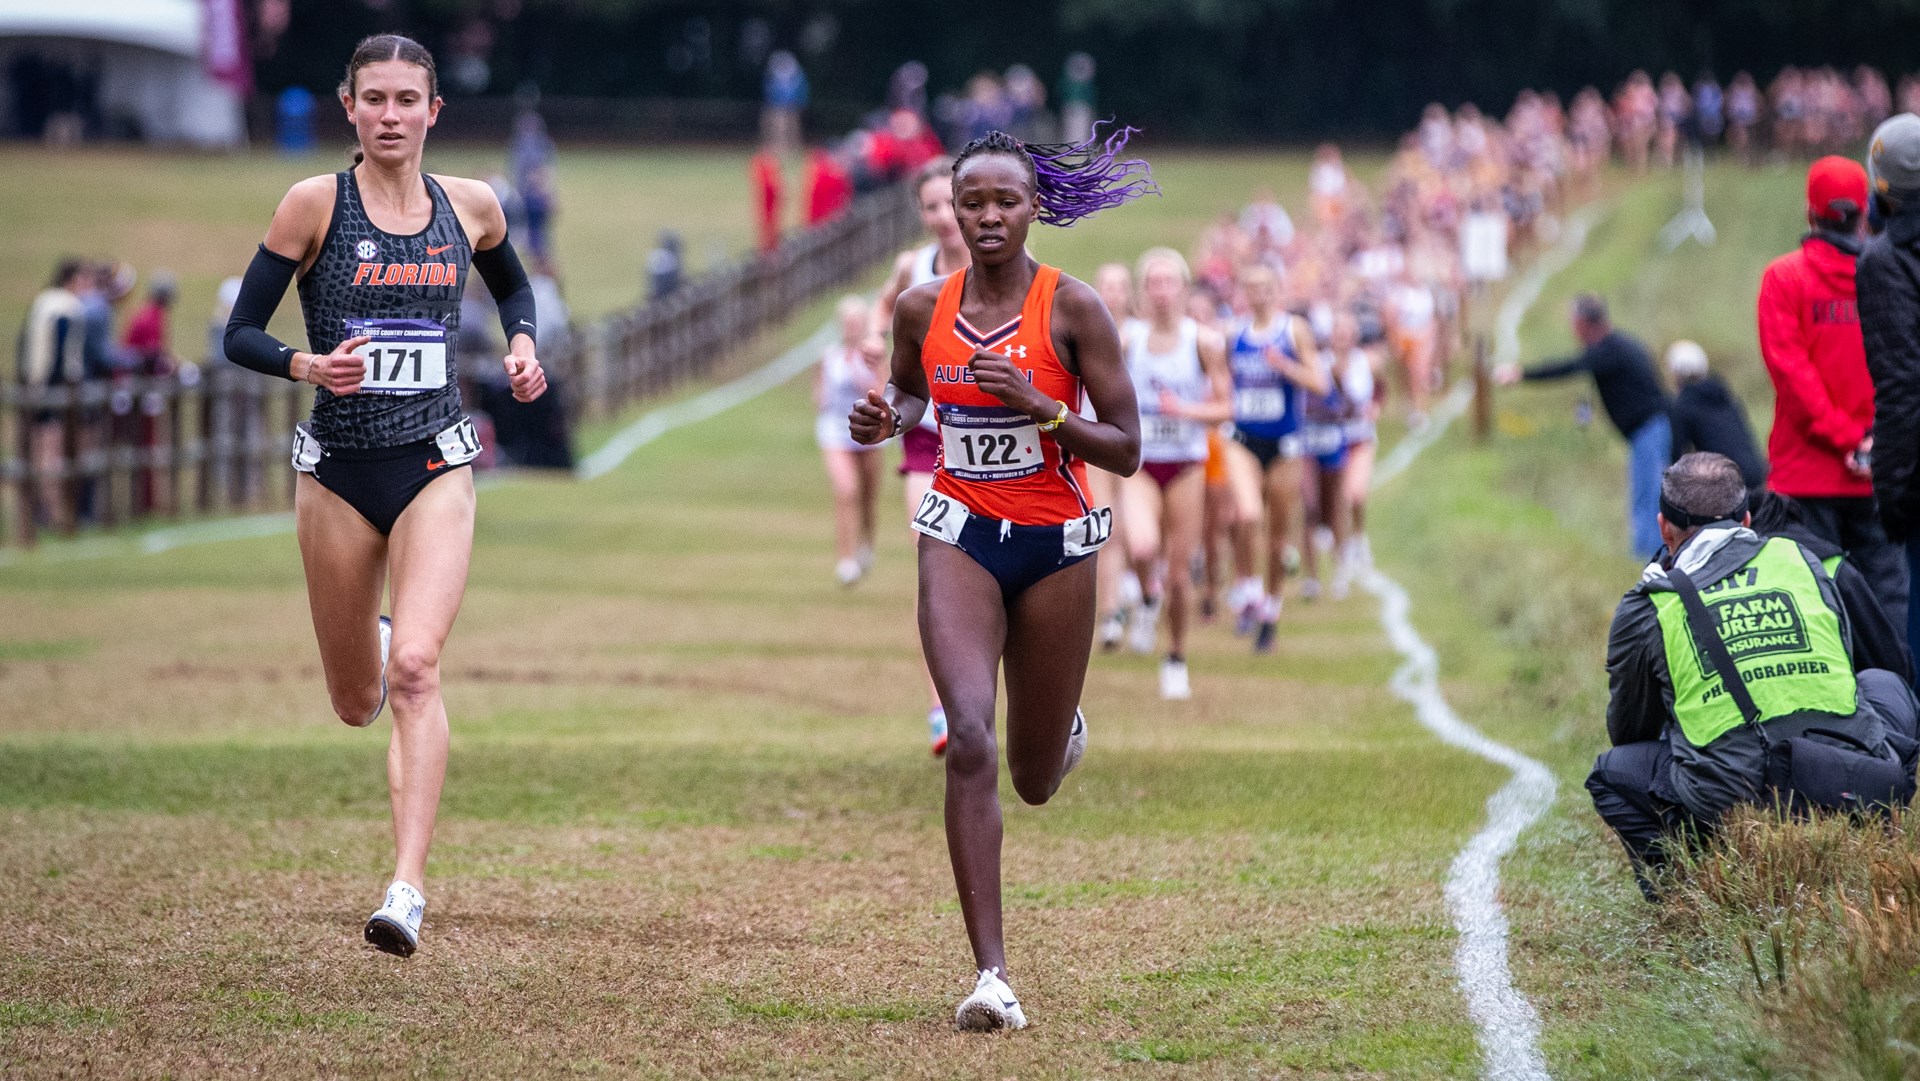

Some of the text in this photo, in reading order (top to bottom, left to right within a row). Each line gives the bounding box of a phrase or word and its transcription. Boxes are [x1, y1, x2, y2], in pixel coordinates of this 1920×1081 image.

[356, 240, 377, 260] SEC
[351, 262, 457, 287] FLORIDA
[362, 329, 380, 337] CROSS
[380, 329, 404, 337] COUNTRY
[404, 330, 444, 338] CHAMPIONSHIPS
[368, 348, 423, 383] 171
[934, 364, 1034, 385] AUBN
[951, 415, 967, 423] CROSS
[967, 416, 989, 424] COUNTRY
[990, 414, 1031, 424] CHAMPIONSHIPS
[960, 433, 1022, 466] 122
[1719, 596, 1788, 621] FARM
[1716, 612, 1793, 640] UREAU
[1726, 633, 1799, 655] NSURANCE
[1702, 661, 1830, 704] PHOGRAPHER
